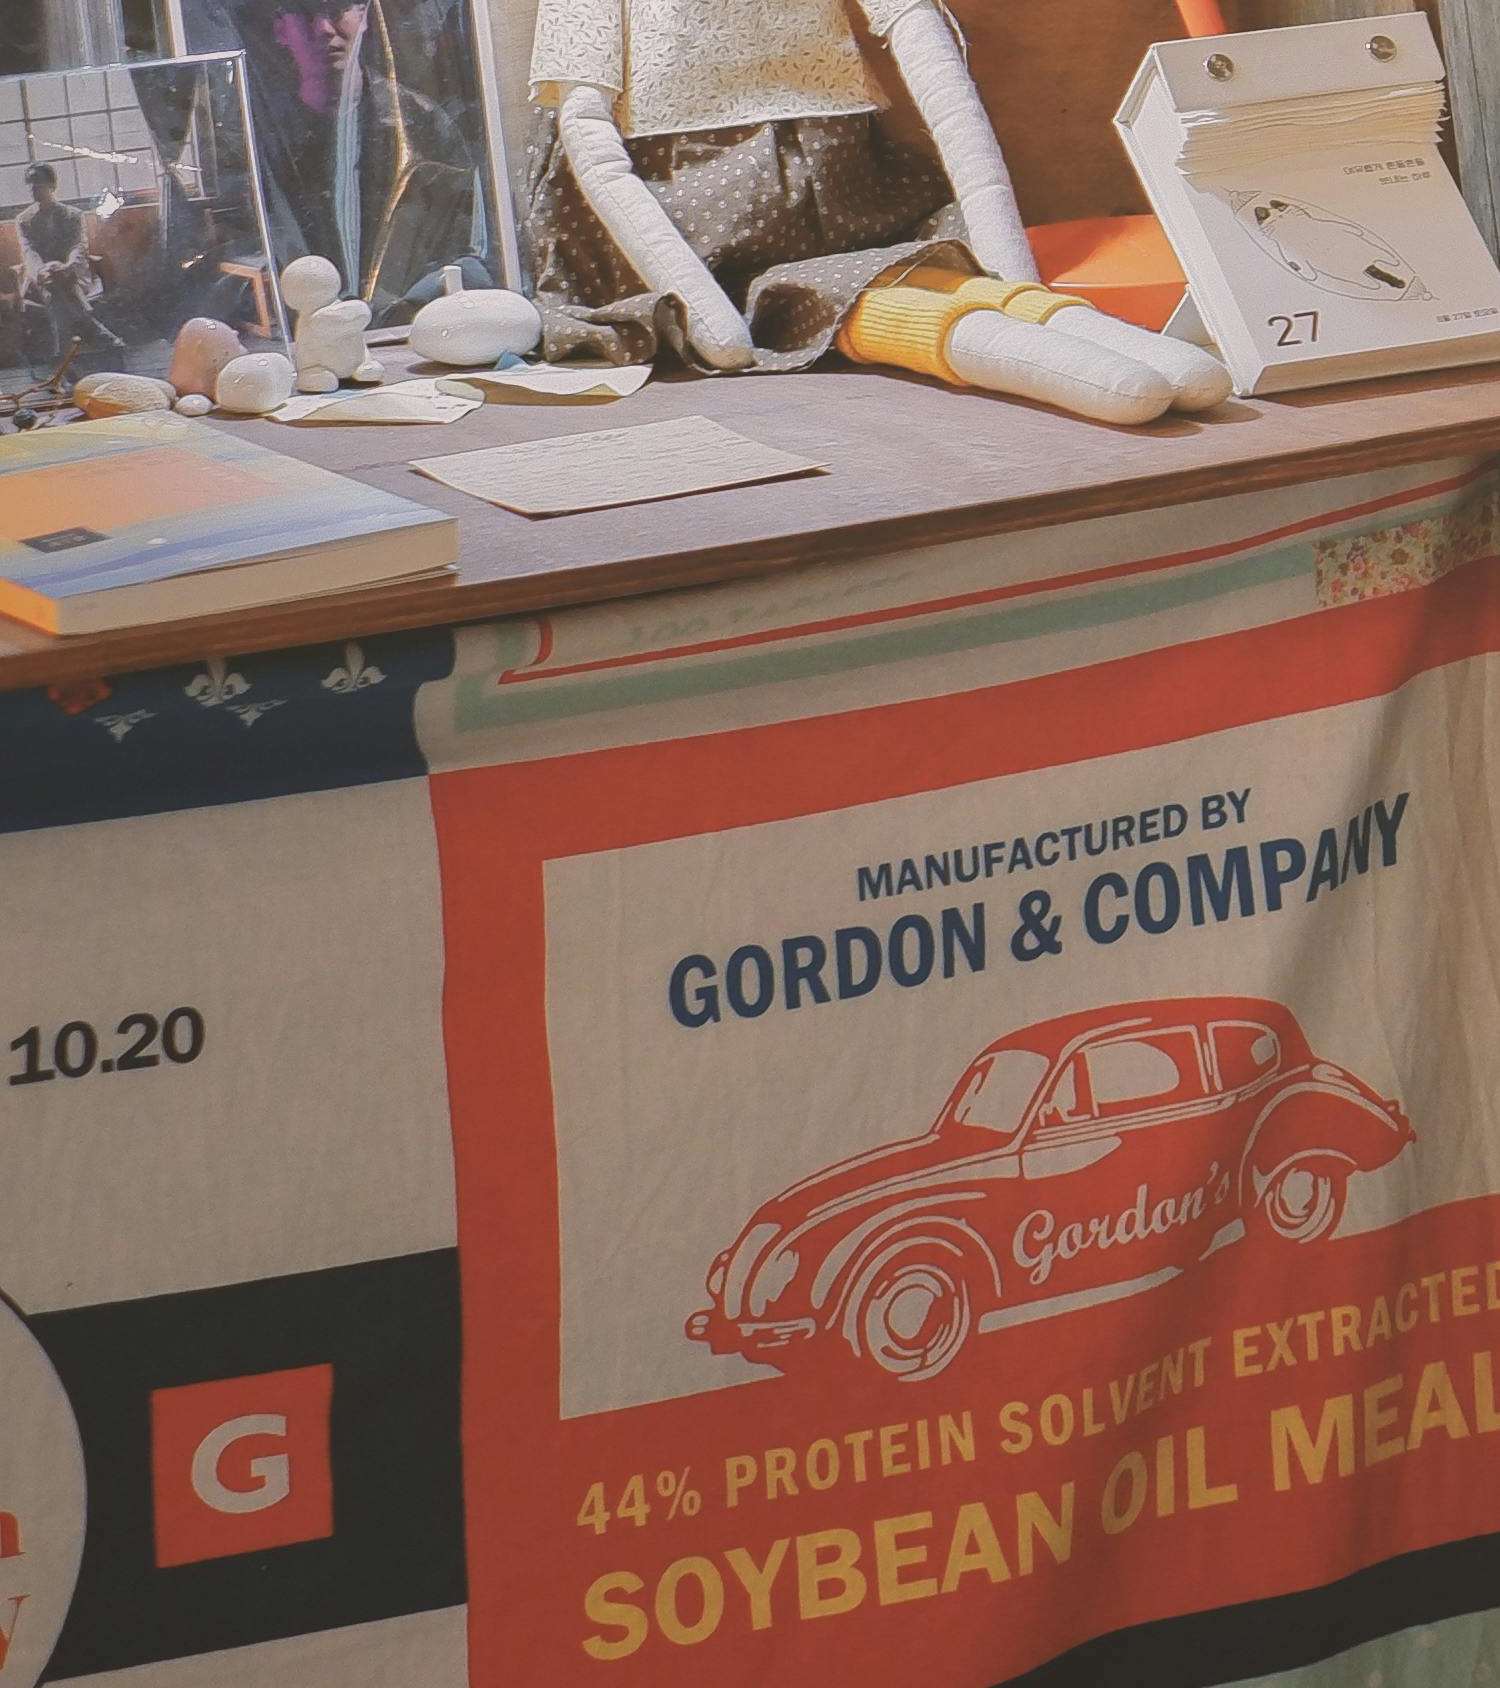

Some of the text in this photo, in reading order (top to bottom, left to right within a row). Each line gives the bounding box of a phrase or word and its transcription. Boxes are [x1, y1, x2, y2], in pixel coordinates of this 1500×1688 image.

[1268, 312, 1322, 348] 27
[854, 788, 1253, 901] MANUFACTURED BY
[667, 790, 1411, 1030] GORDON & COMPANY
[7, 1004, 206, 1087] 10.20
[1012, 1160, 1235, 1286] Gordon's
[190, 1412, 290, 1516] G
[575, 1469, 704, 1538] 44%
[724, 1412, 979, 1498] PROTEIN
[996, 1336, 1211, 1455] SOLVENT
[582, 1485, 1079, 1664] SOYBEAN
[1100, 1432, 1242, 1538] OIL
